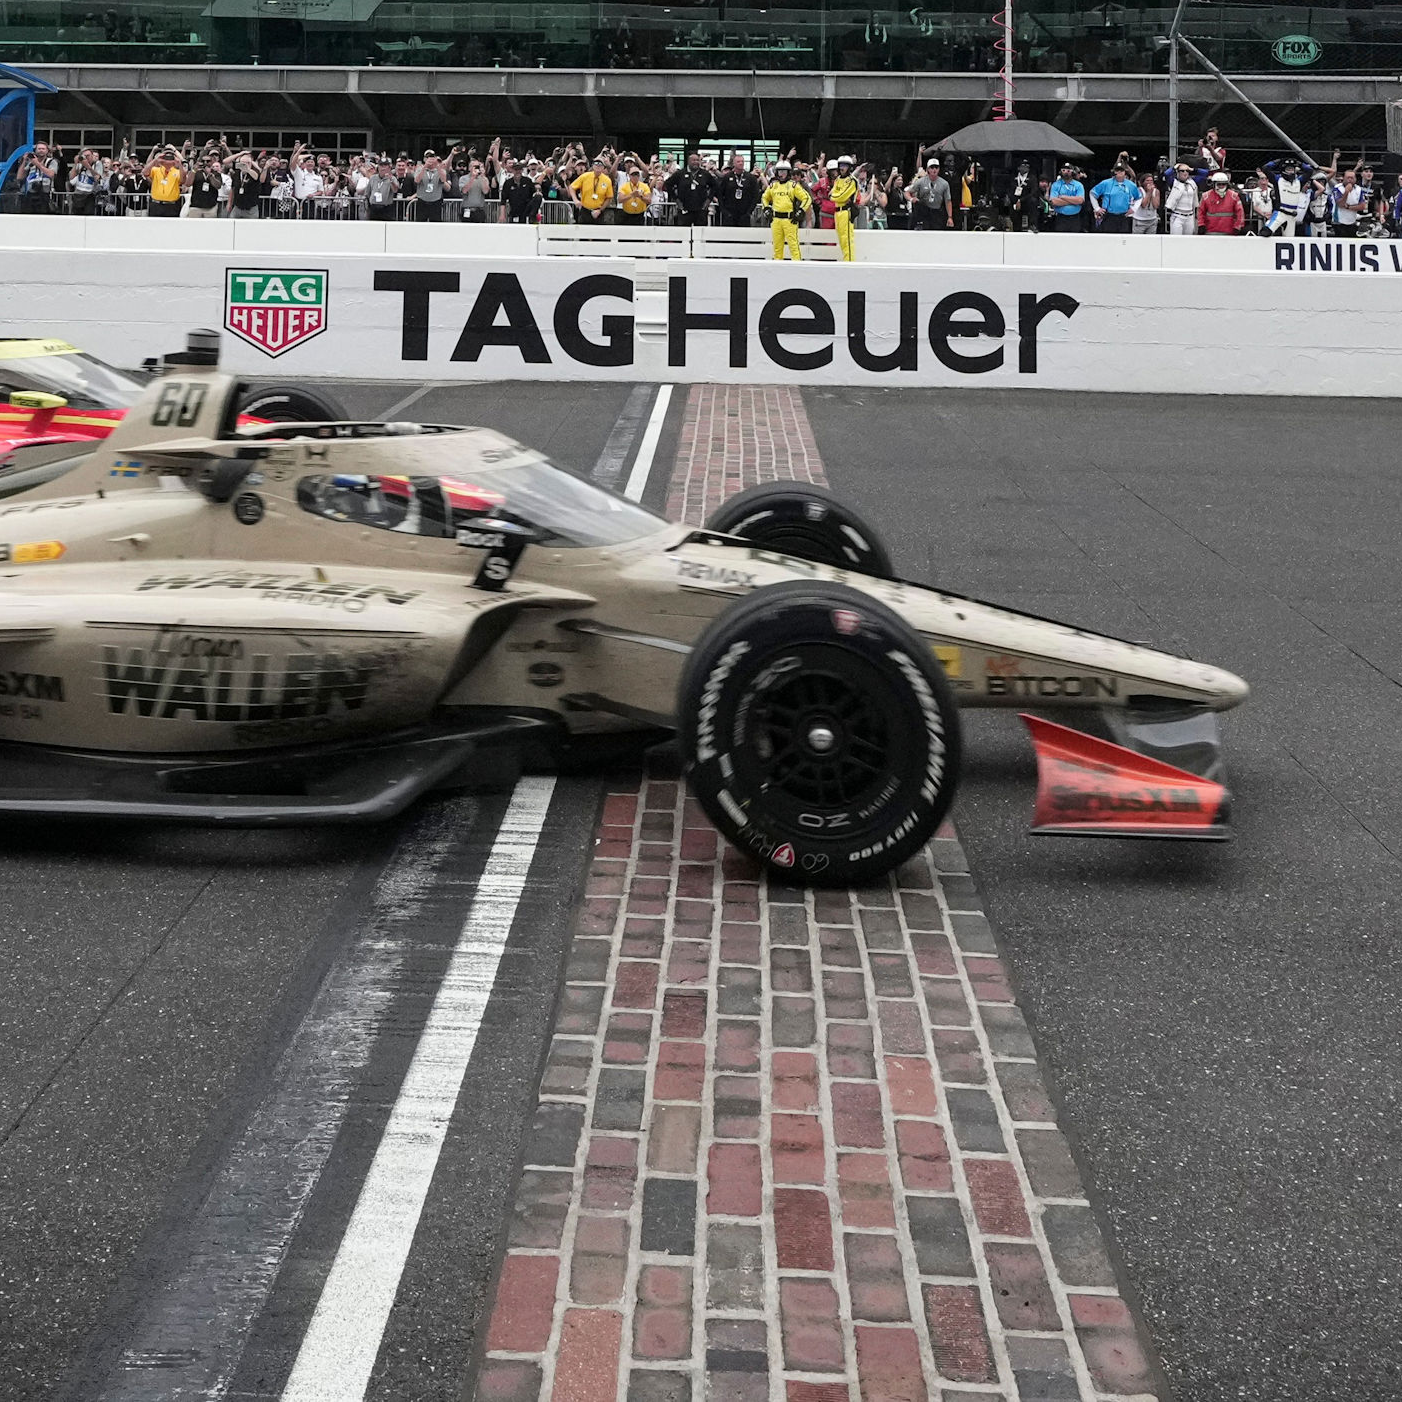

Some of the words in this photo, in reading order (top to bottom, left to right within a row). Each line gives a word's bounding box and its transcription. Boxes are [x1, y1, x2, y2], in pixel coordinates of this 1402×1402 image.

[1282, 41, 1311, 54] FOX
[236, 276, 317, 303] TAG
[231, 307, 321, 350] HEUER
[151, 382, 209, 428] 60
[137, 574, 427, 606] WALLEN
[261, 590, 367, 614] RADIO
[101, 645, 375, 722] WALLEN
[885, 809, 920, 849] INDY
[848, 842, 884, 862] 500
